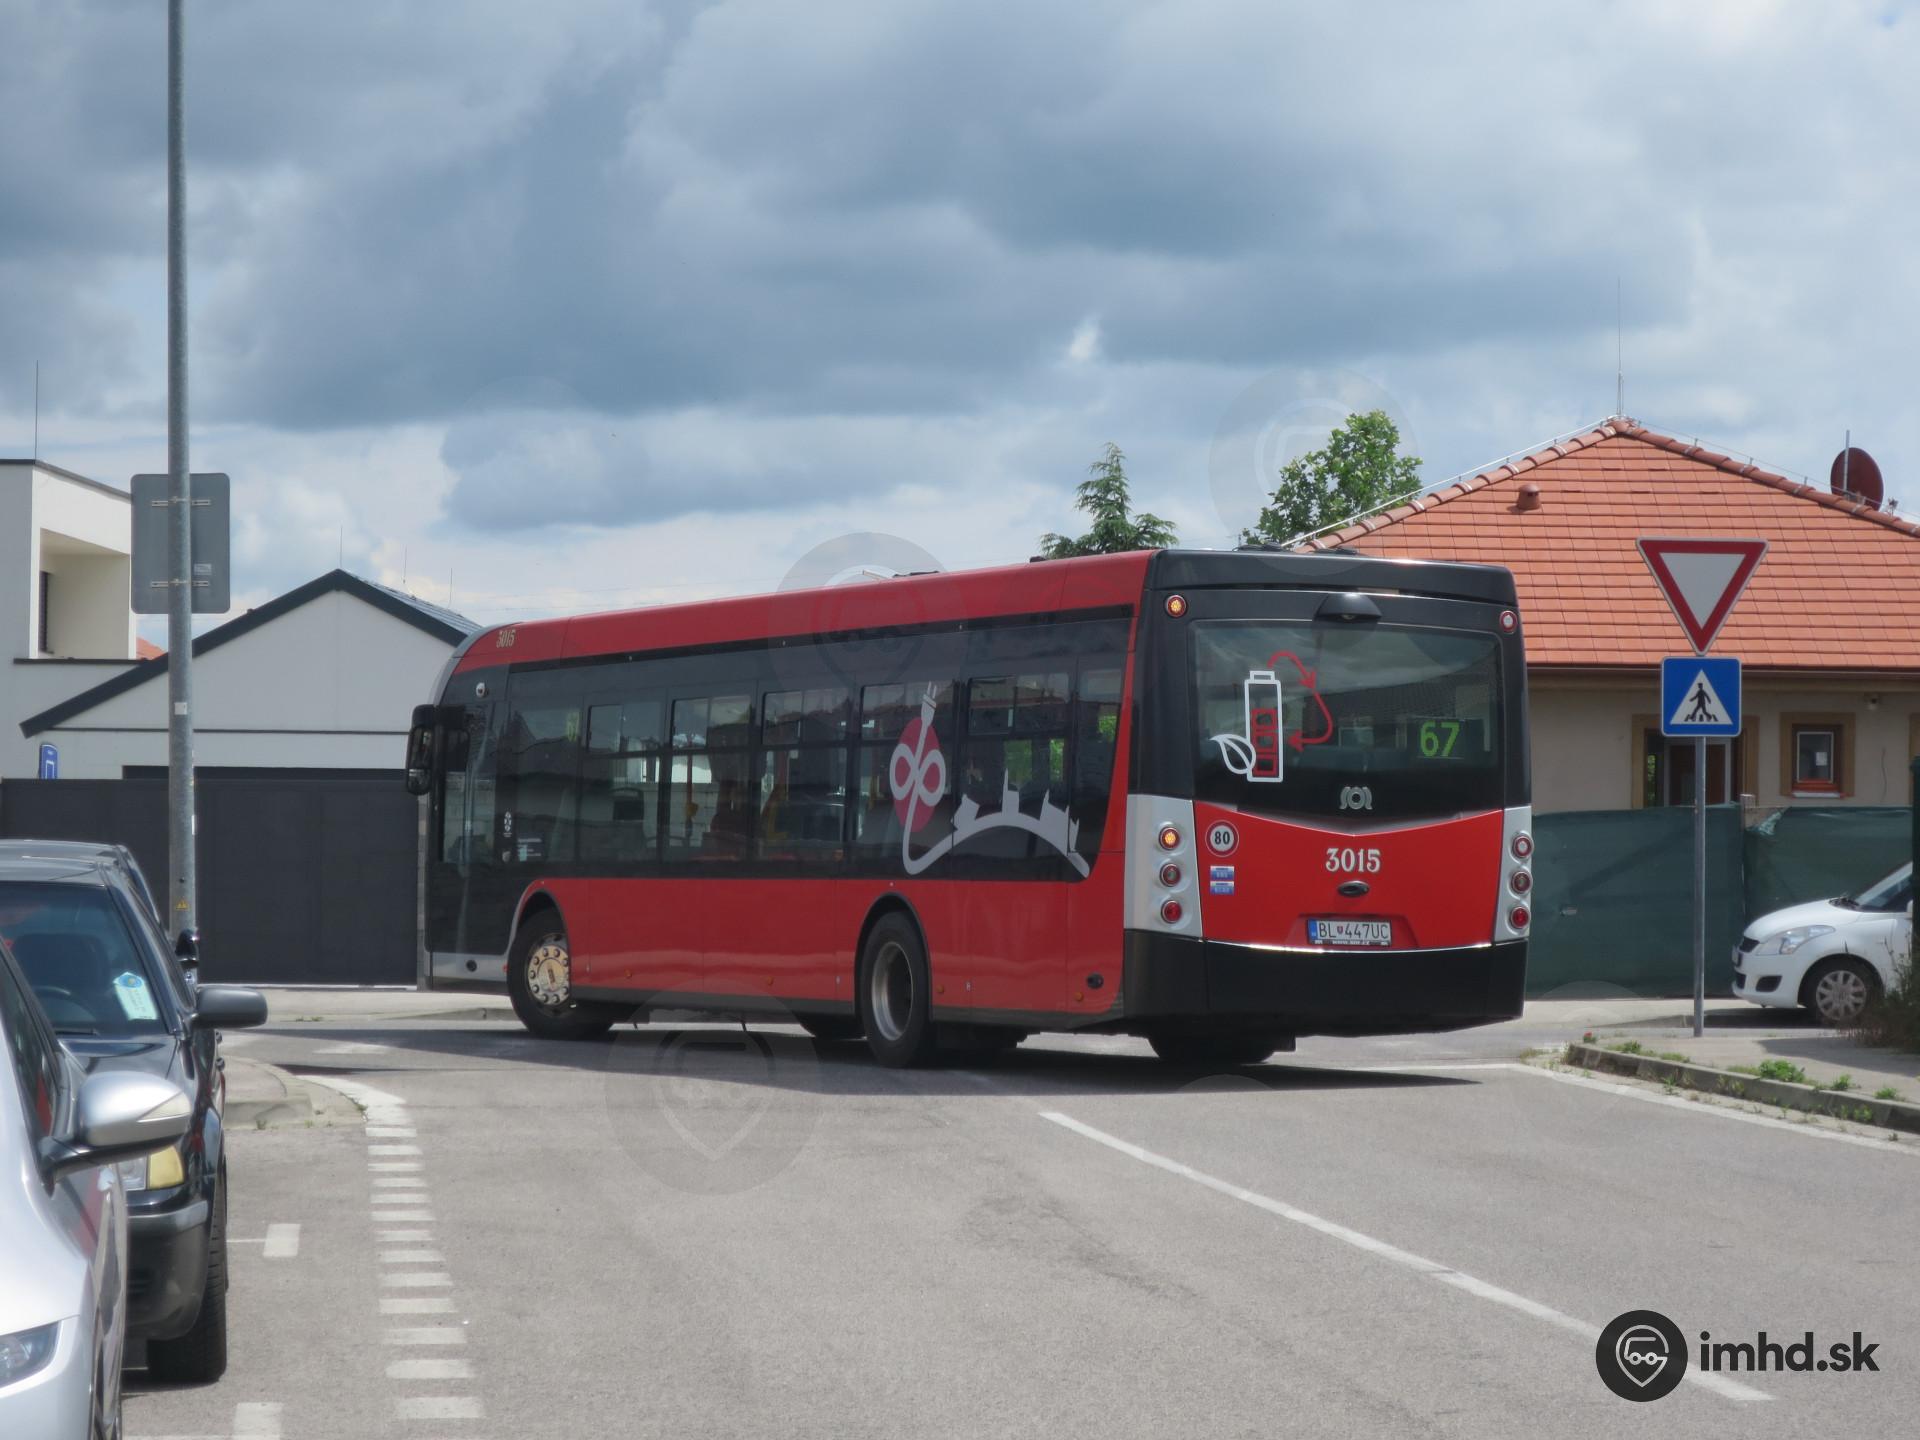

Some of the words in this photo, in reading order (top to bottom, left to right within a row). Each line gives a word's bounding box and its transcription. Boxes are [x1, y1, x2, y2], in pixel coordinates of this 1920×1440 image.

[1420, 720, 1460, 757] 67
[1214, 831, 1231, 845] 80
[1325, 848, 1381, 872] 3015
